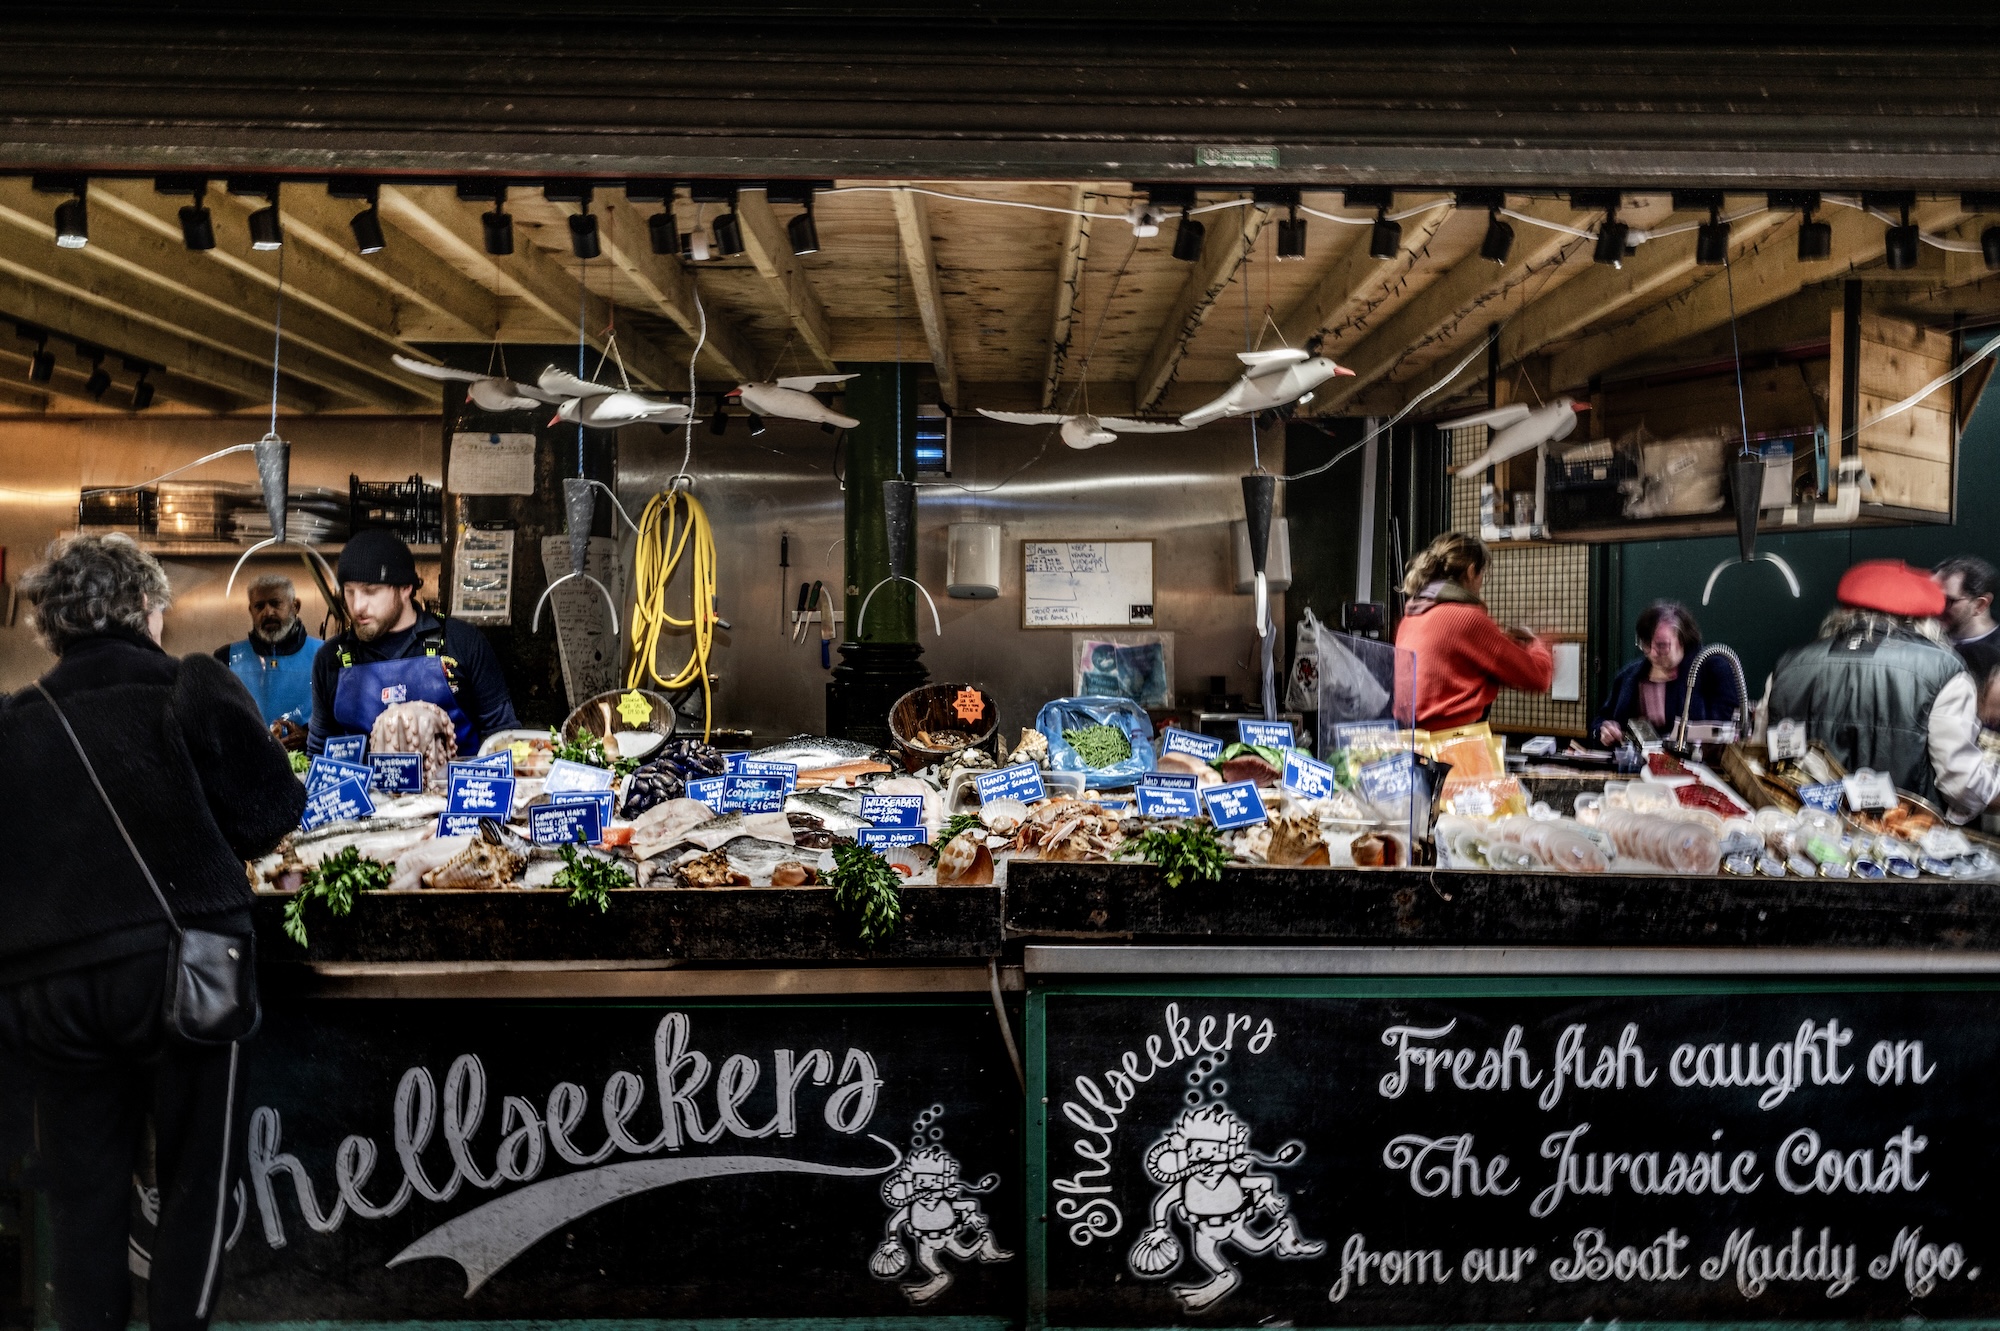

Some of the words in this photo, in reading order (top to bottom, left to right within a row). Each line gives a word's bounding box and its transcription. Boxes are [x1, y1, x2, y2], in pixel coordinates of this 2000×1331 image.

[736, 778, 768, 789] DORSET
[982, 775, 1007, 788] HAND
[983, 781, 1010, 797] DORSET
[446, 815, 480, 829] SHETLAN
[865, 833, 886, 842] HAND
[1378, 1017, 1542, 1100] Fresh
[1538, 1021, 1659, 1111] fish
[1669, 1017, 1854, 1111] caught
[1866, 1038, 1937, 1086] on
[225, 1012, 884, 1250] hellseekers
[1053, 1002, 1278, 1246] Shellseekers
[1383, 1131, 1521, 1199] The
[1529, 1122, 1765, 1218] Jurassic
[1774, 1124, 1932, 1194] Coast
[1328, 1232, 1454, 1303] from
[1461, 1244, 1538, 1285] our
[1549, 1227, 1690, 1283] Boat
[1699, 1226, 1860, 1299] Maddy
[1868, 1225, 1981, 1298] Moo.
